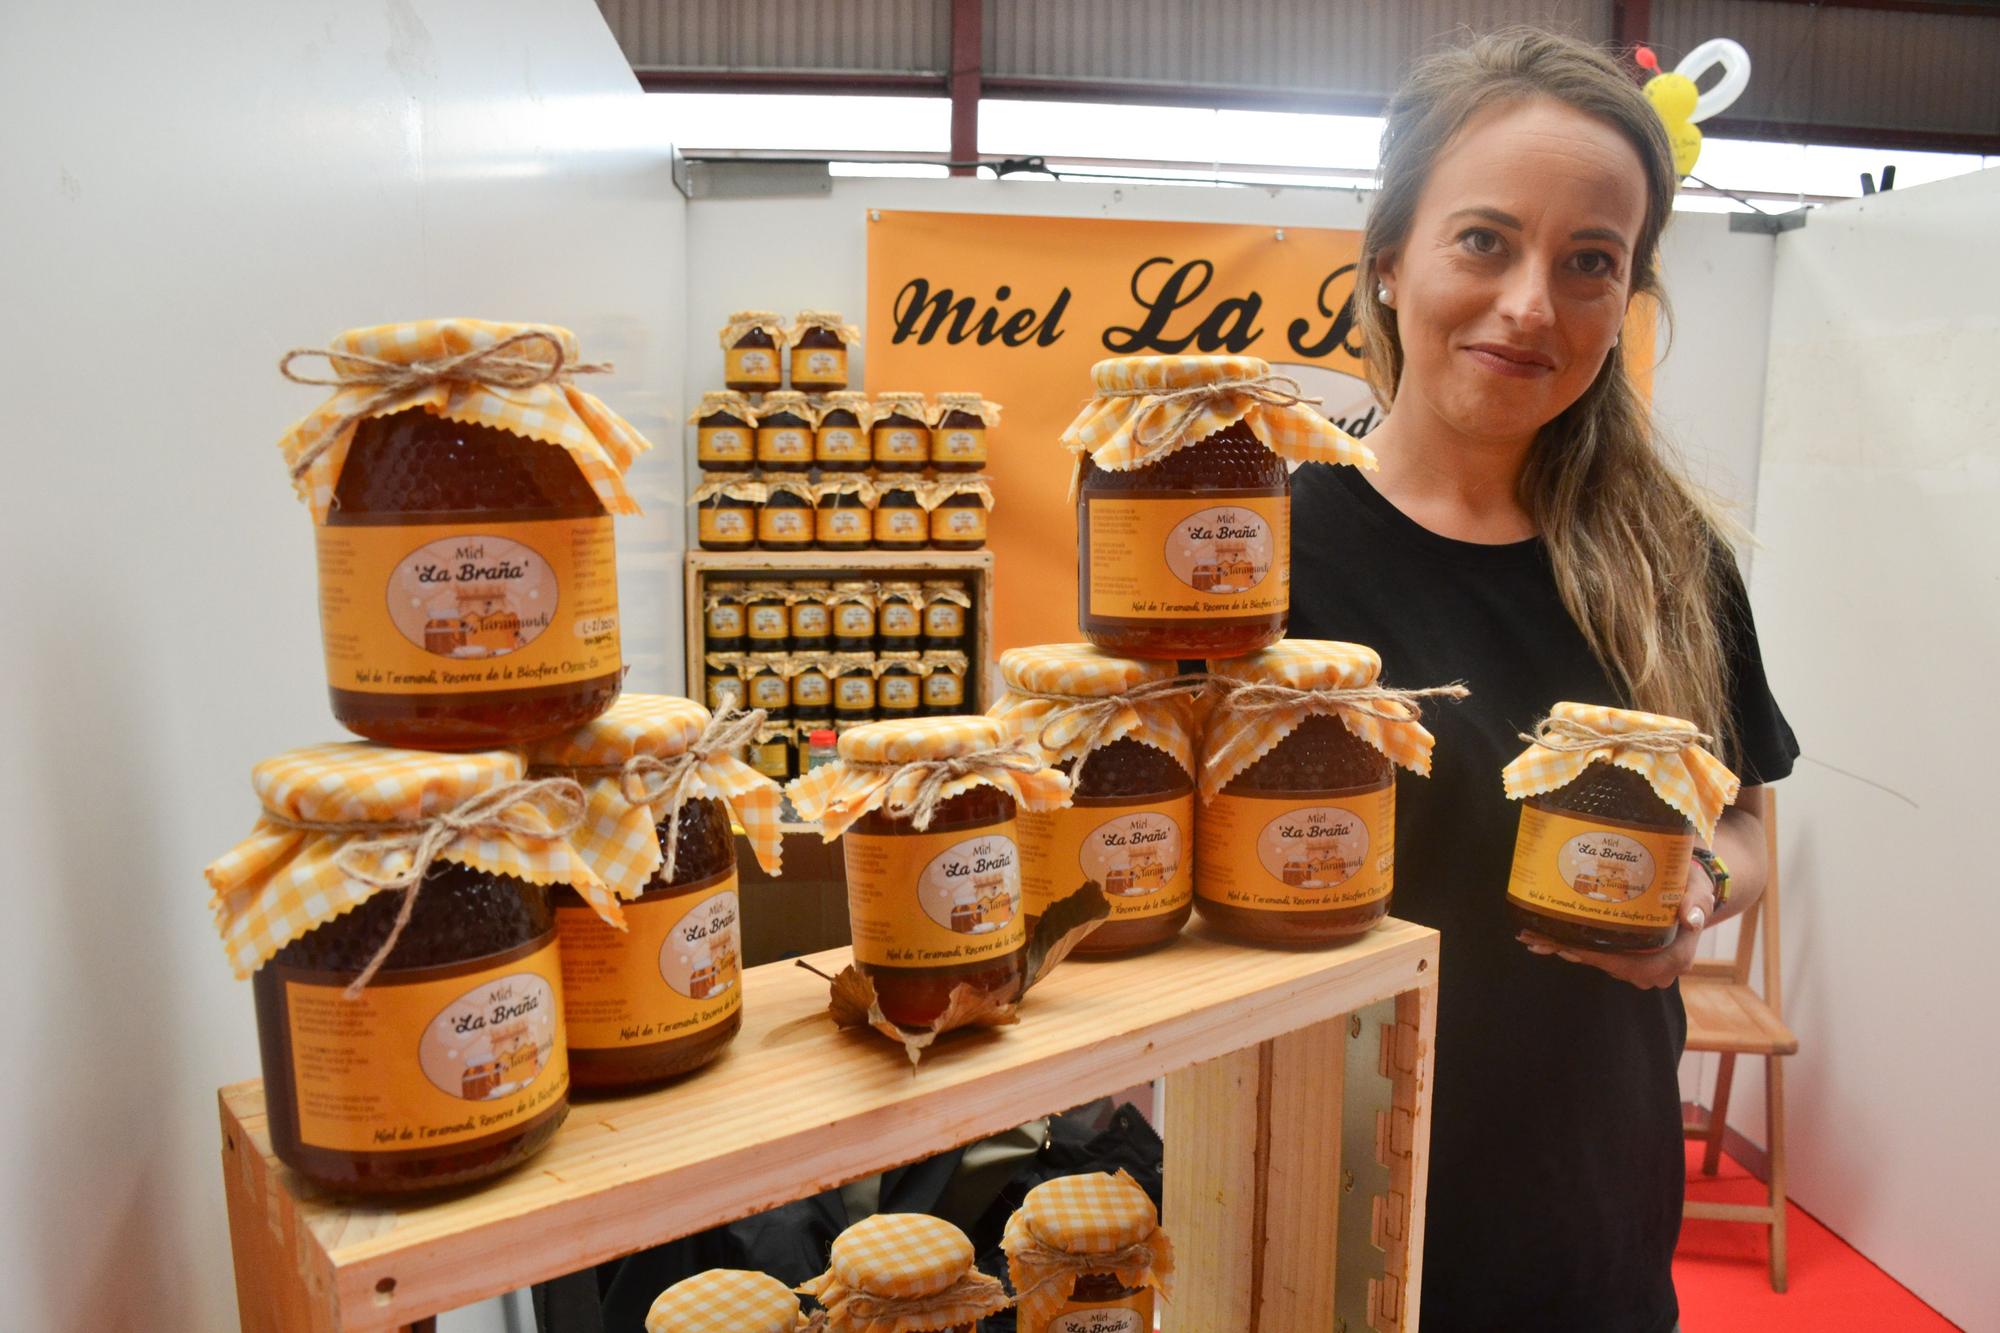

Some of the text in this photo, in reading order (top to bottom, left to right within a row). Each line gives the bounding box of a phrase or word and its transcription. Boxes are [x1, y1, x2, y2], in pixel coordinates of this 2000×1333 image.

[891, 278, 1071, 347] Miel
[1101, 257, 1264, 354] La
[1217, 512, 1235, 524] Miel
[456, 544, 484, 560] Miel
[486, 667, 499, 680] de
[503, 664, 513, 679] la
[1130, 818, 1147, 830] Miel
[1307, 812, 1326, 823] Miel
[973, 840, 991, 857] Miel
[374, 1128, 397, 1144] Miel
[400, 1127, 413, 1141] de
[516, 1101, 526, 1114] de
